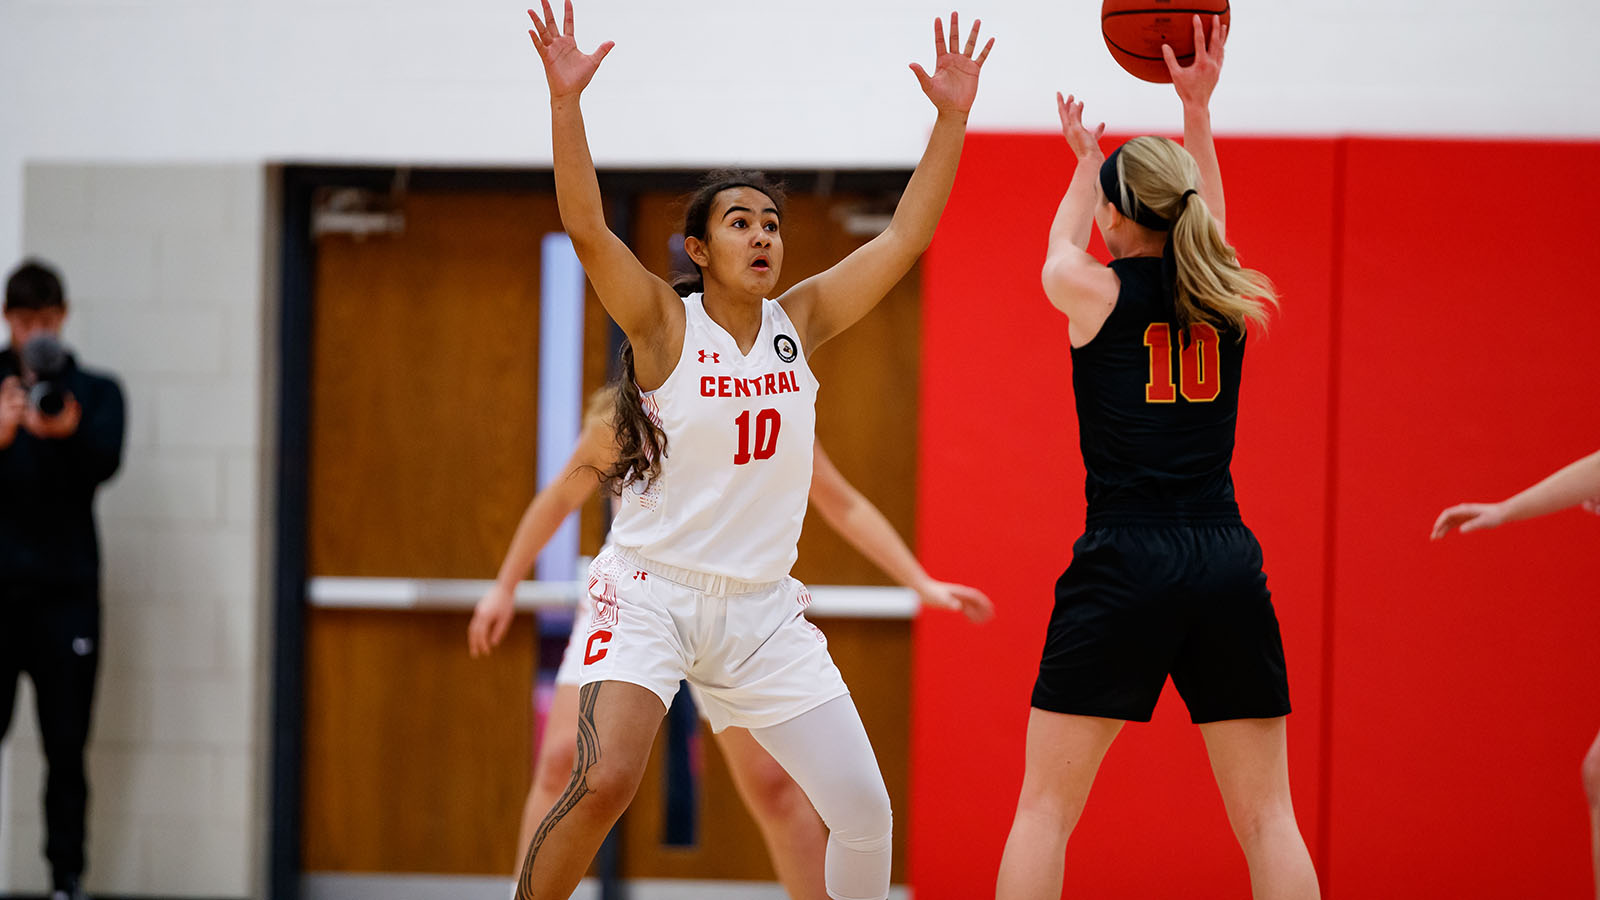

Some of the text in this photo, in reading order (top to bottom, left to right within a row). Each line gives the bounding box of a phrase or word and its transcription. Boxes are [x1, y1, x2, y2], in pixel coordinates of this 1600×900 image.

[700, 370, 800, 398] CENTRAL
[1144, 322, 1221, 403] 10
[733, 408, 782, 465] 10
[583, 630, 613, 666] C
